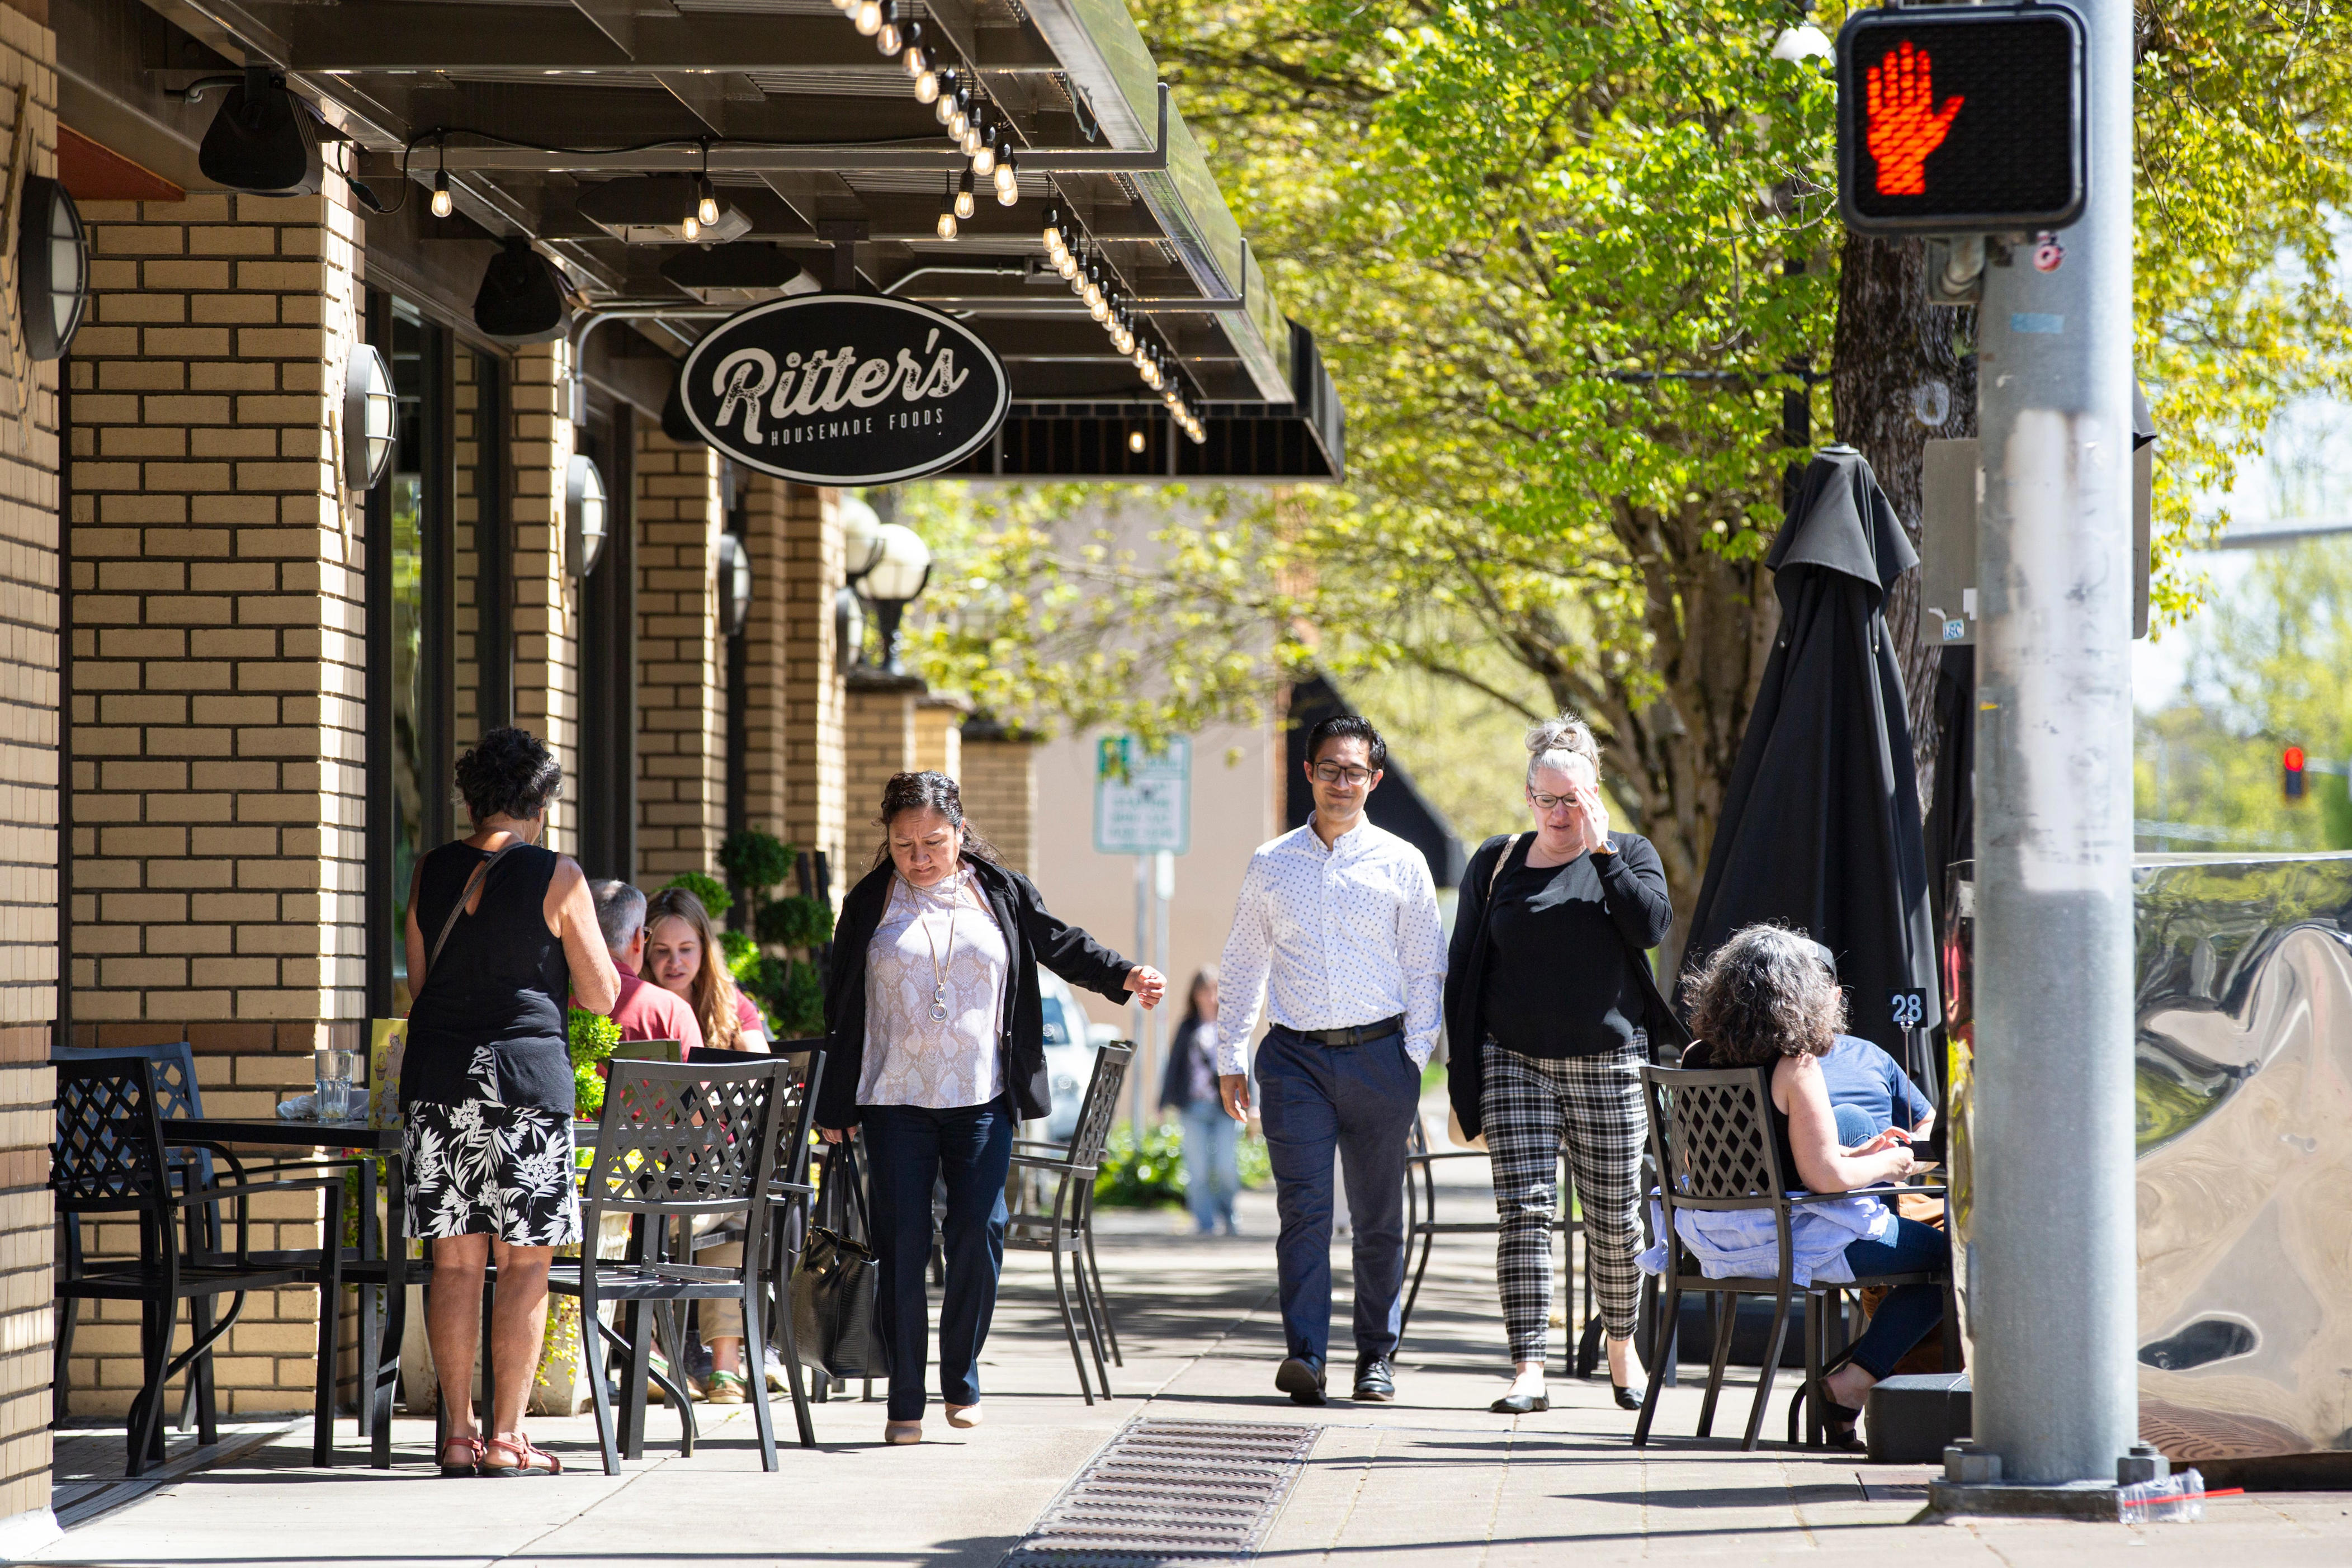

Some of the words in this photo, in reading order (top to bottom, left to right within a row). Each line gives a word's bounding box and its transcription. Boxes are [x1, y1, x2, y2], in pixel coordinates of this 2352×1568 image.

[712, 328, 969, 445] Ritter's
[771, 418, 872, 446] HOUSEMADE
[890, 408, 943, 430] FOODS
[1892, 994, 1922, 1022] 28
